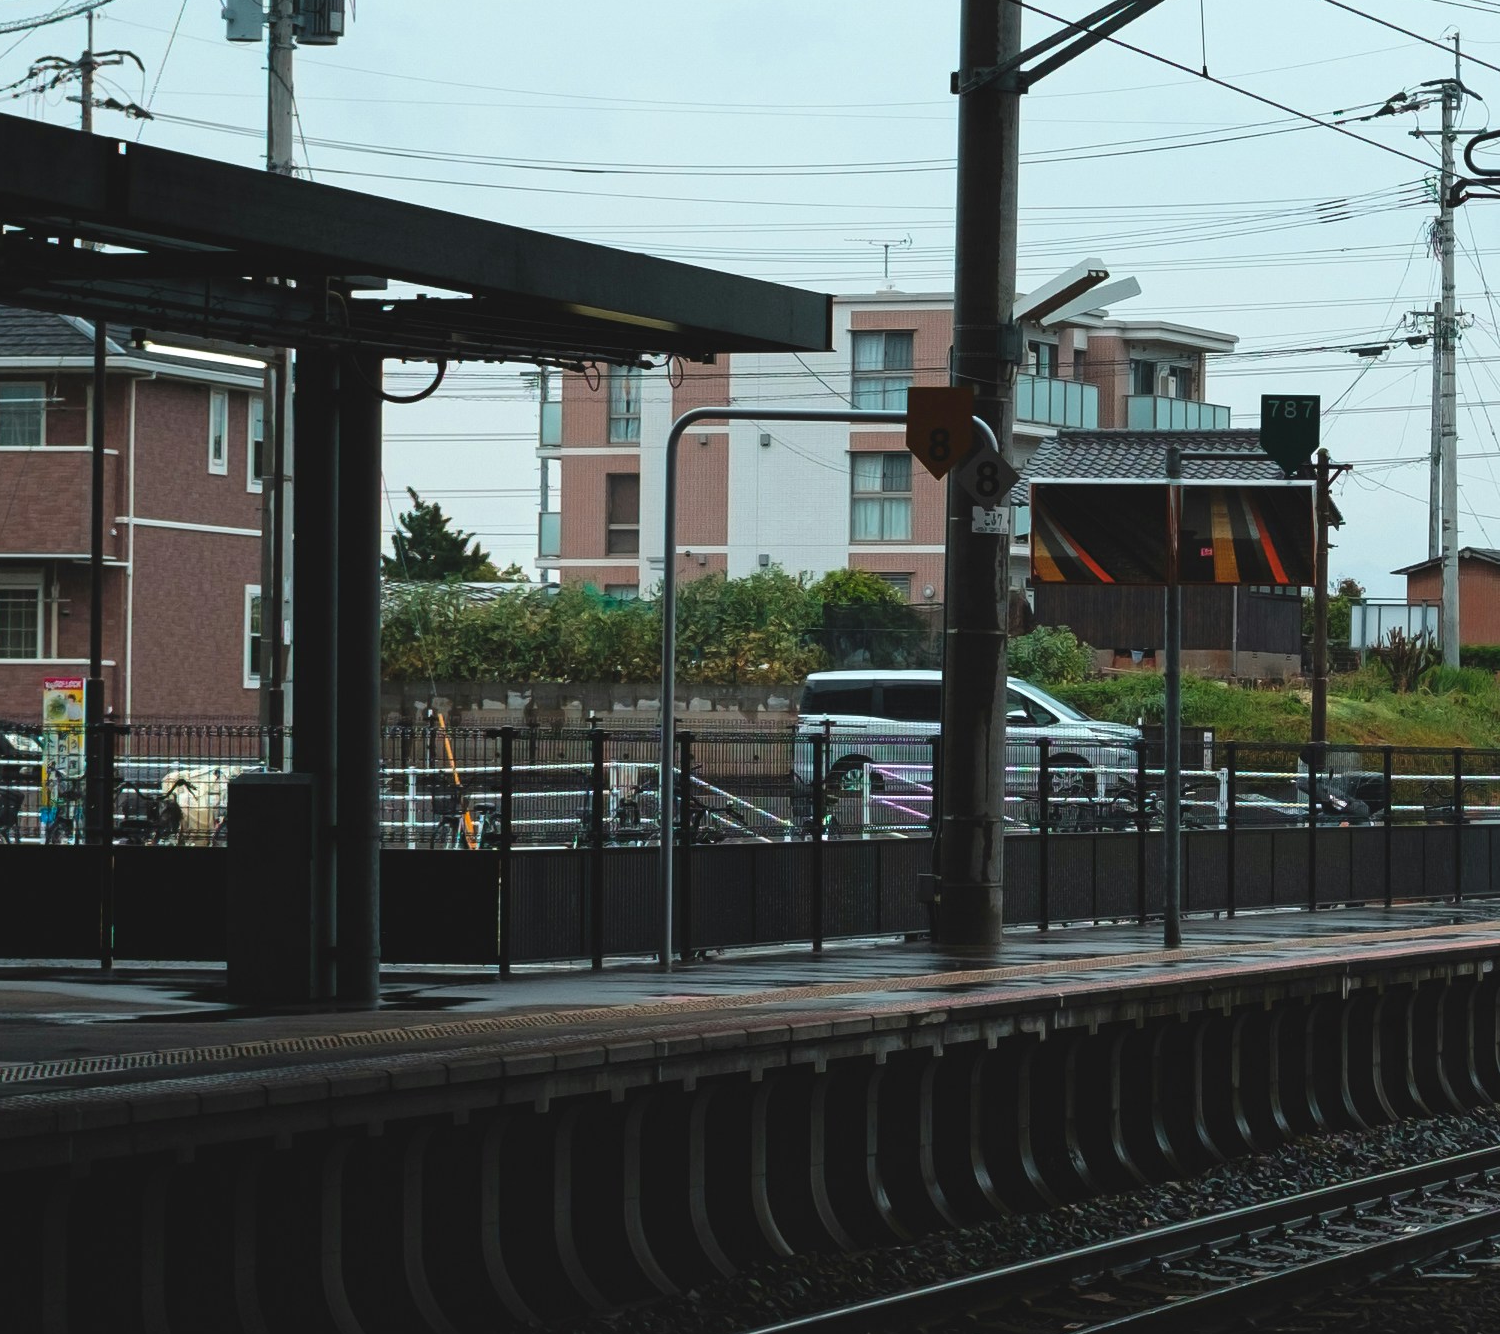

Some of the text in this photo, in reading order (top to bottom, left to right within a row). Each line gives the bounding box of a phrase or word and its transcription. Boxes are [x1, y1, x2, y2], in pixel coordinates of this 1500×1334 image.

[1268, 400, 1315, 419] 787
[929, 428, 950, 462] 8
[976, 461, 1000, 497] 8
